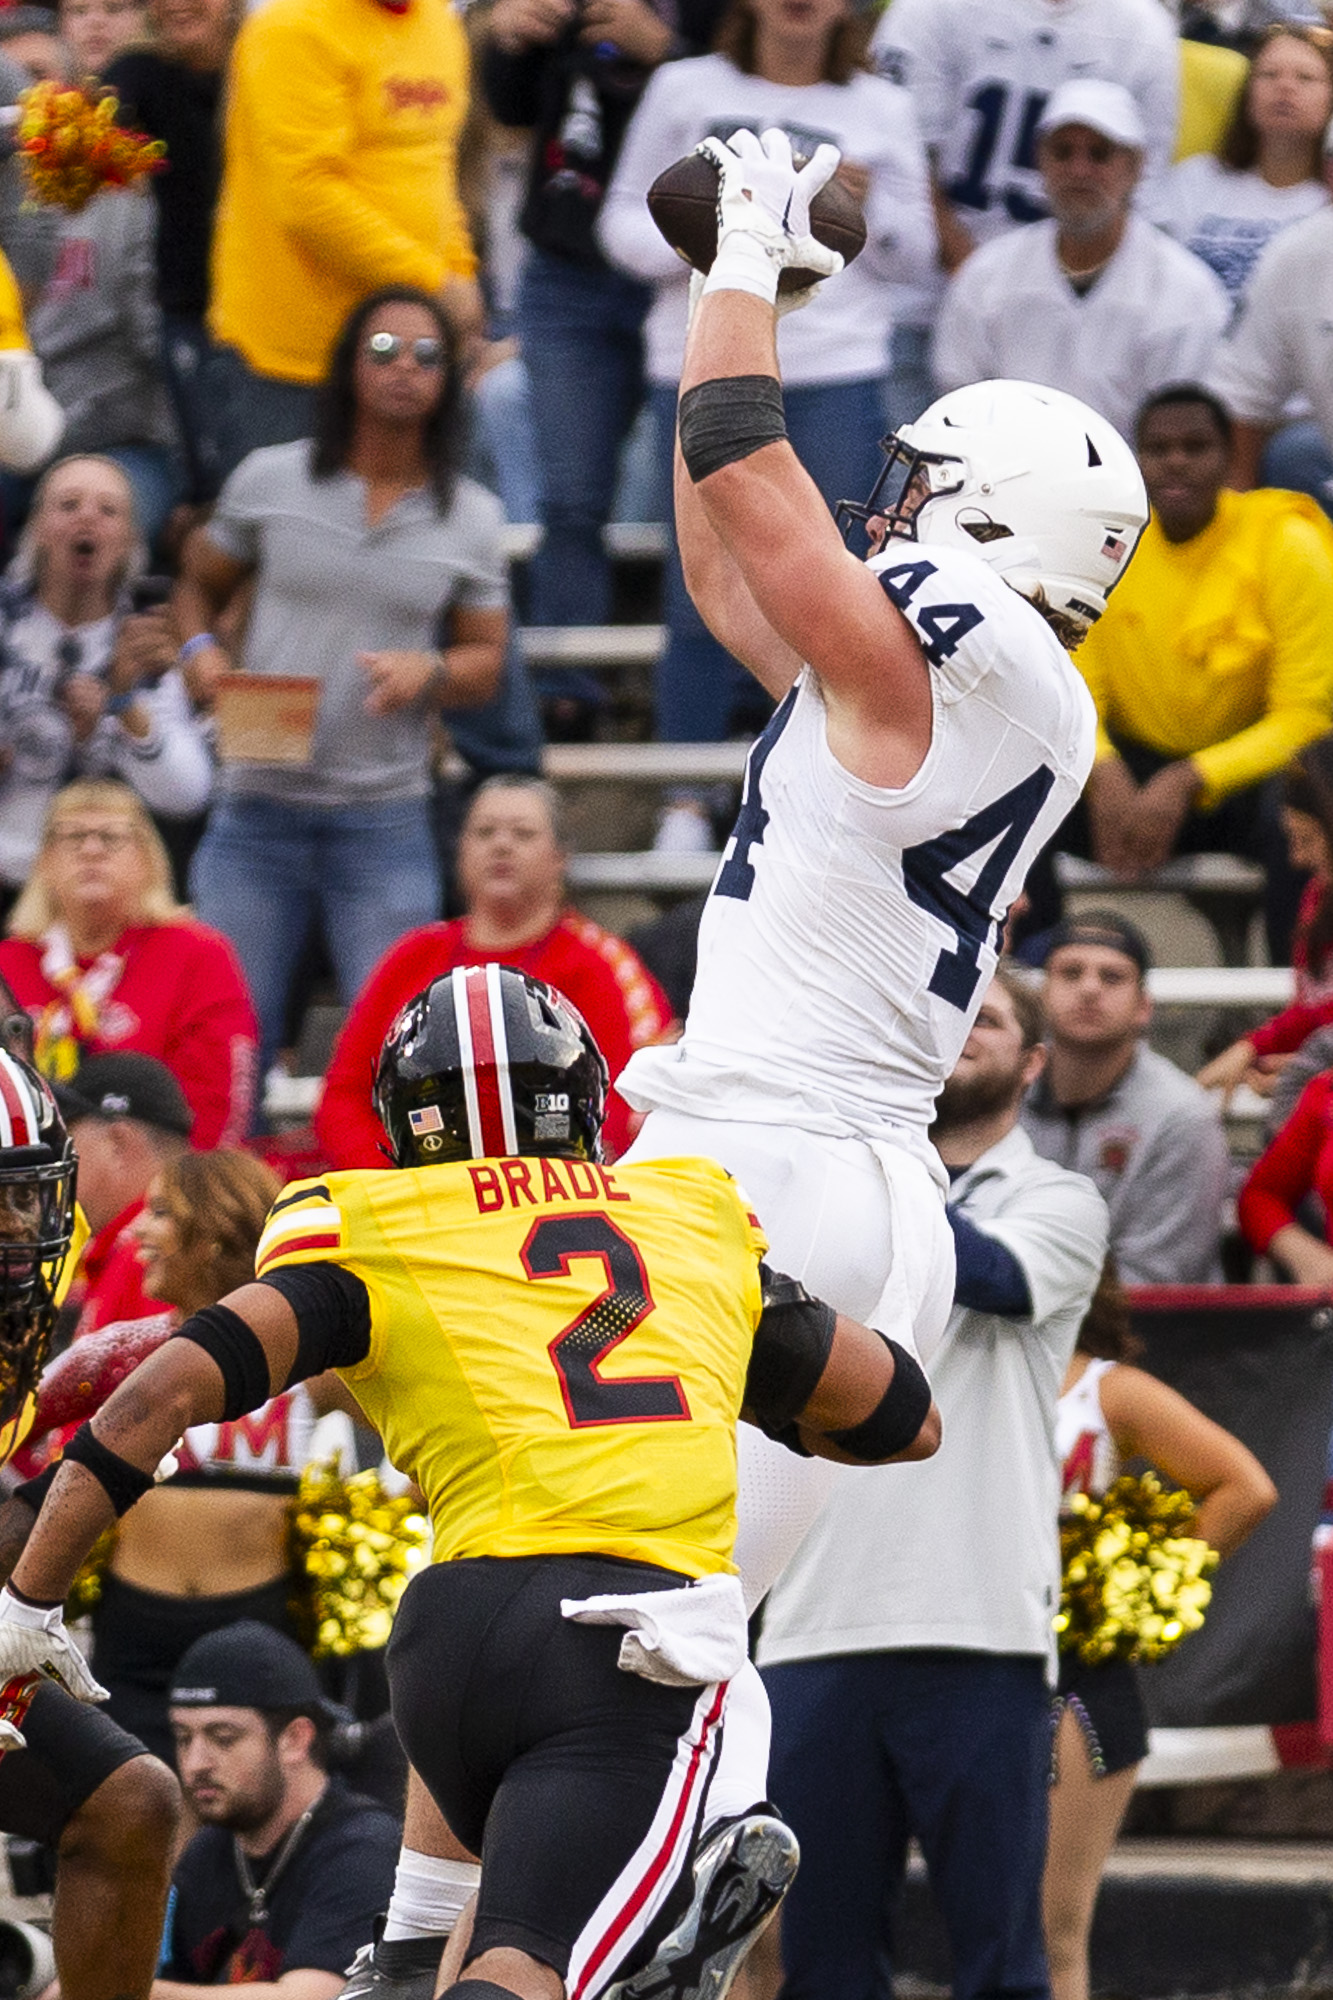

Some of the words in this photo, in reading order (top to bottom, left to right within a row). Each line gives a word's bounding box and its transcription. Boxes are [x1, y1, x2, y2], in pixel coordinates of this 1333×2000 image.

[878, 560, 986, 669] 44
[467, 1157, 631, 1214] BRADE
[519, 1210, 692, 1429] 2
[213, 1392, 294, 1467] M
